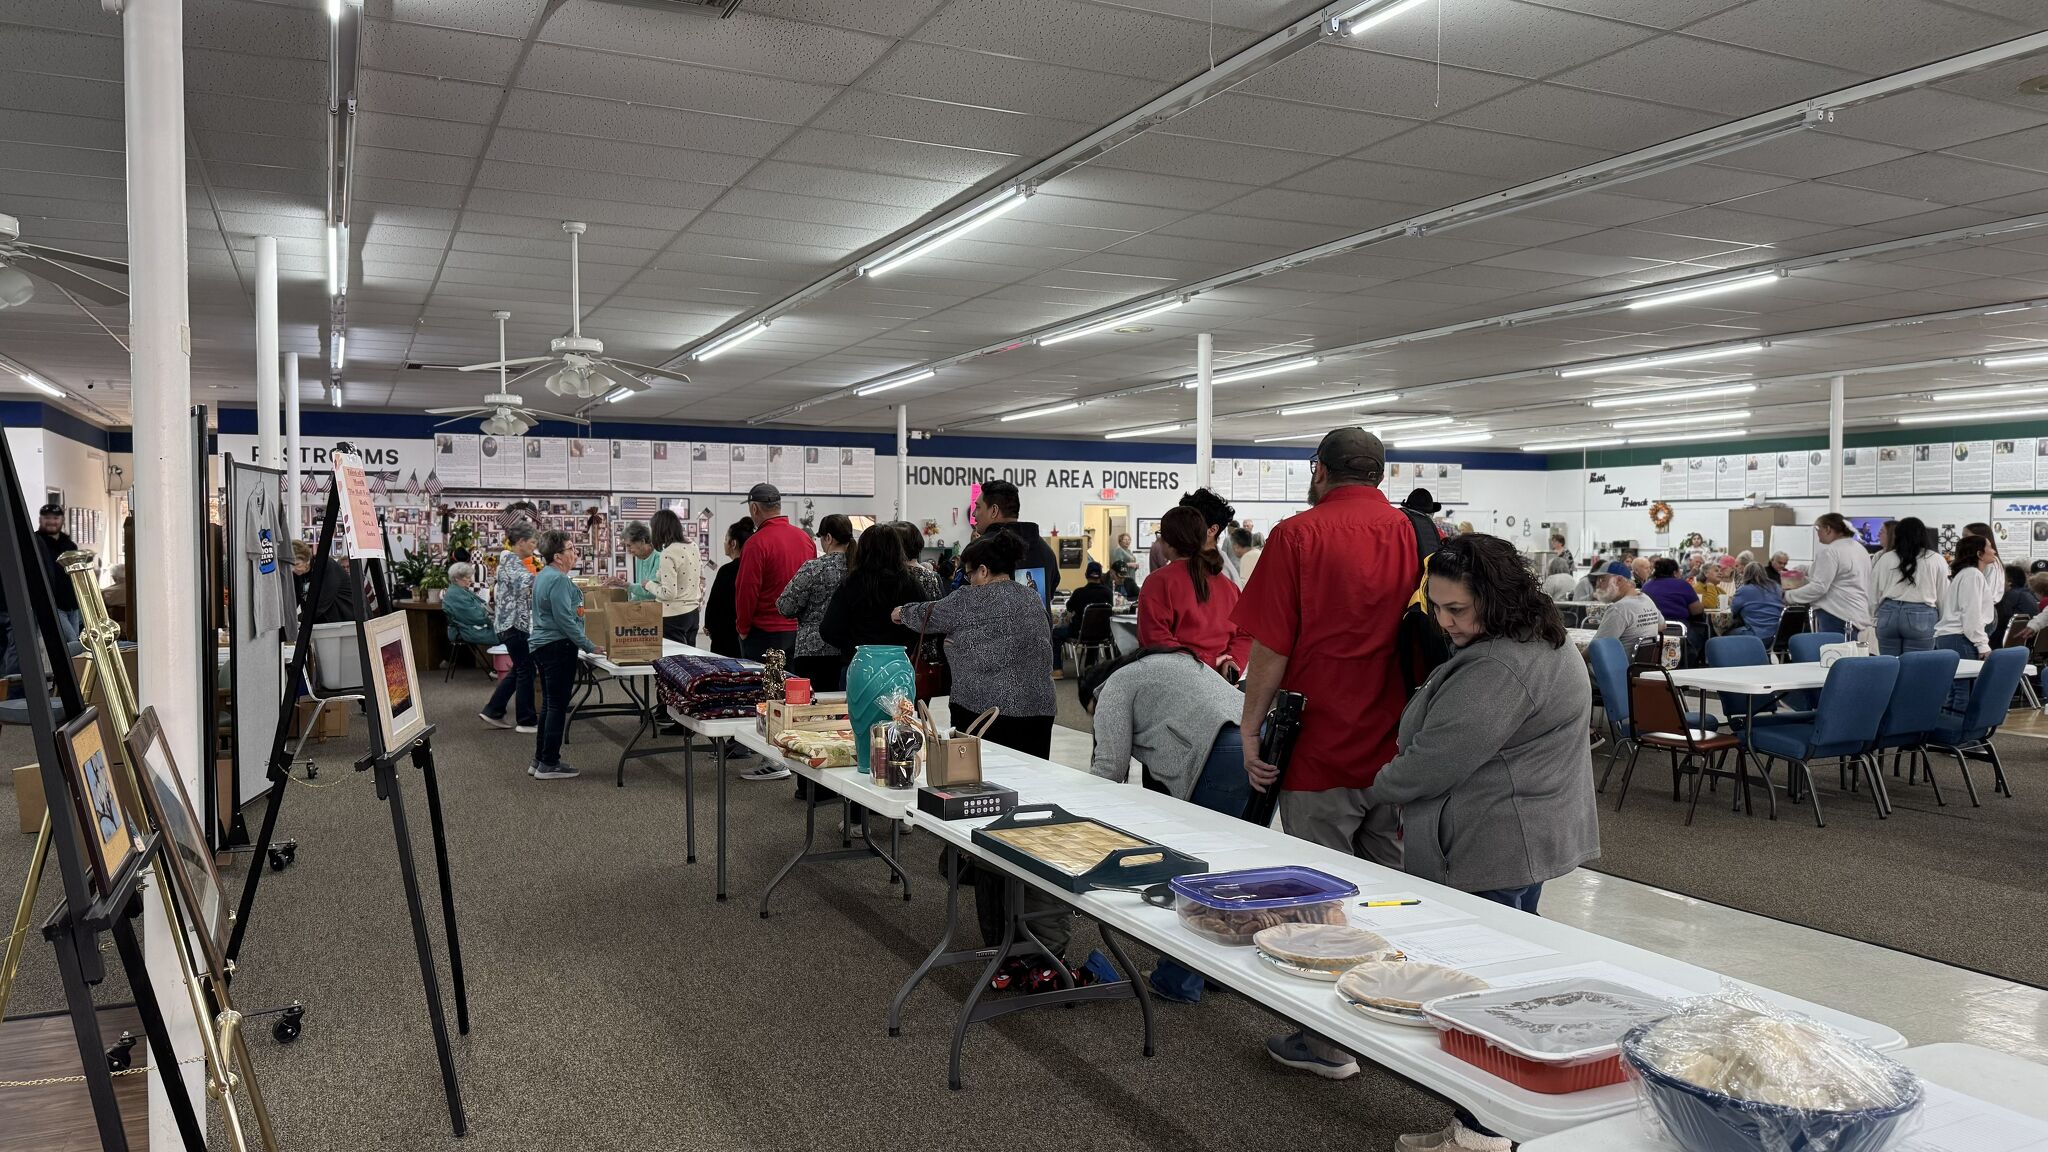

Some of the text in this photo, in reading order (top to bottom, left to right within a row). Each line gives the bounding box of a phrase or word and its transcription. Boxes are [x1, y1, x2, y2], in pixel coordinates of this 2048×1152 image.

[252, 446, 399, 465] RTRMS
[906, 465, 1179, 490] HONORING OUR AREA PIONEERS
[454, 501, 500, 509] WALL OF
[457, 514, 494, 522] HONOR
[615, 625, 658, 637] United
